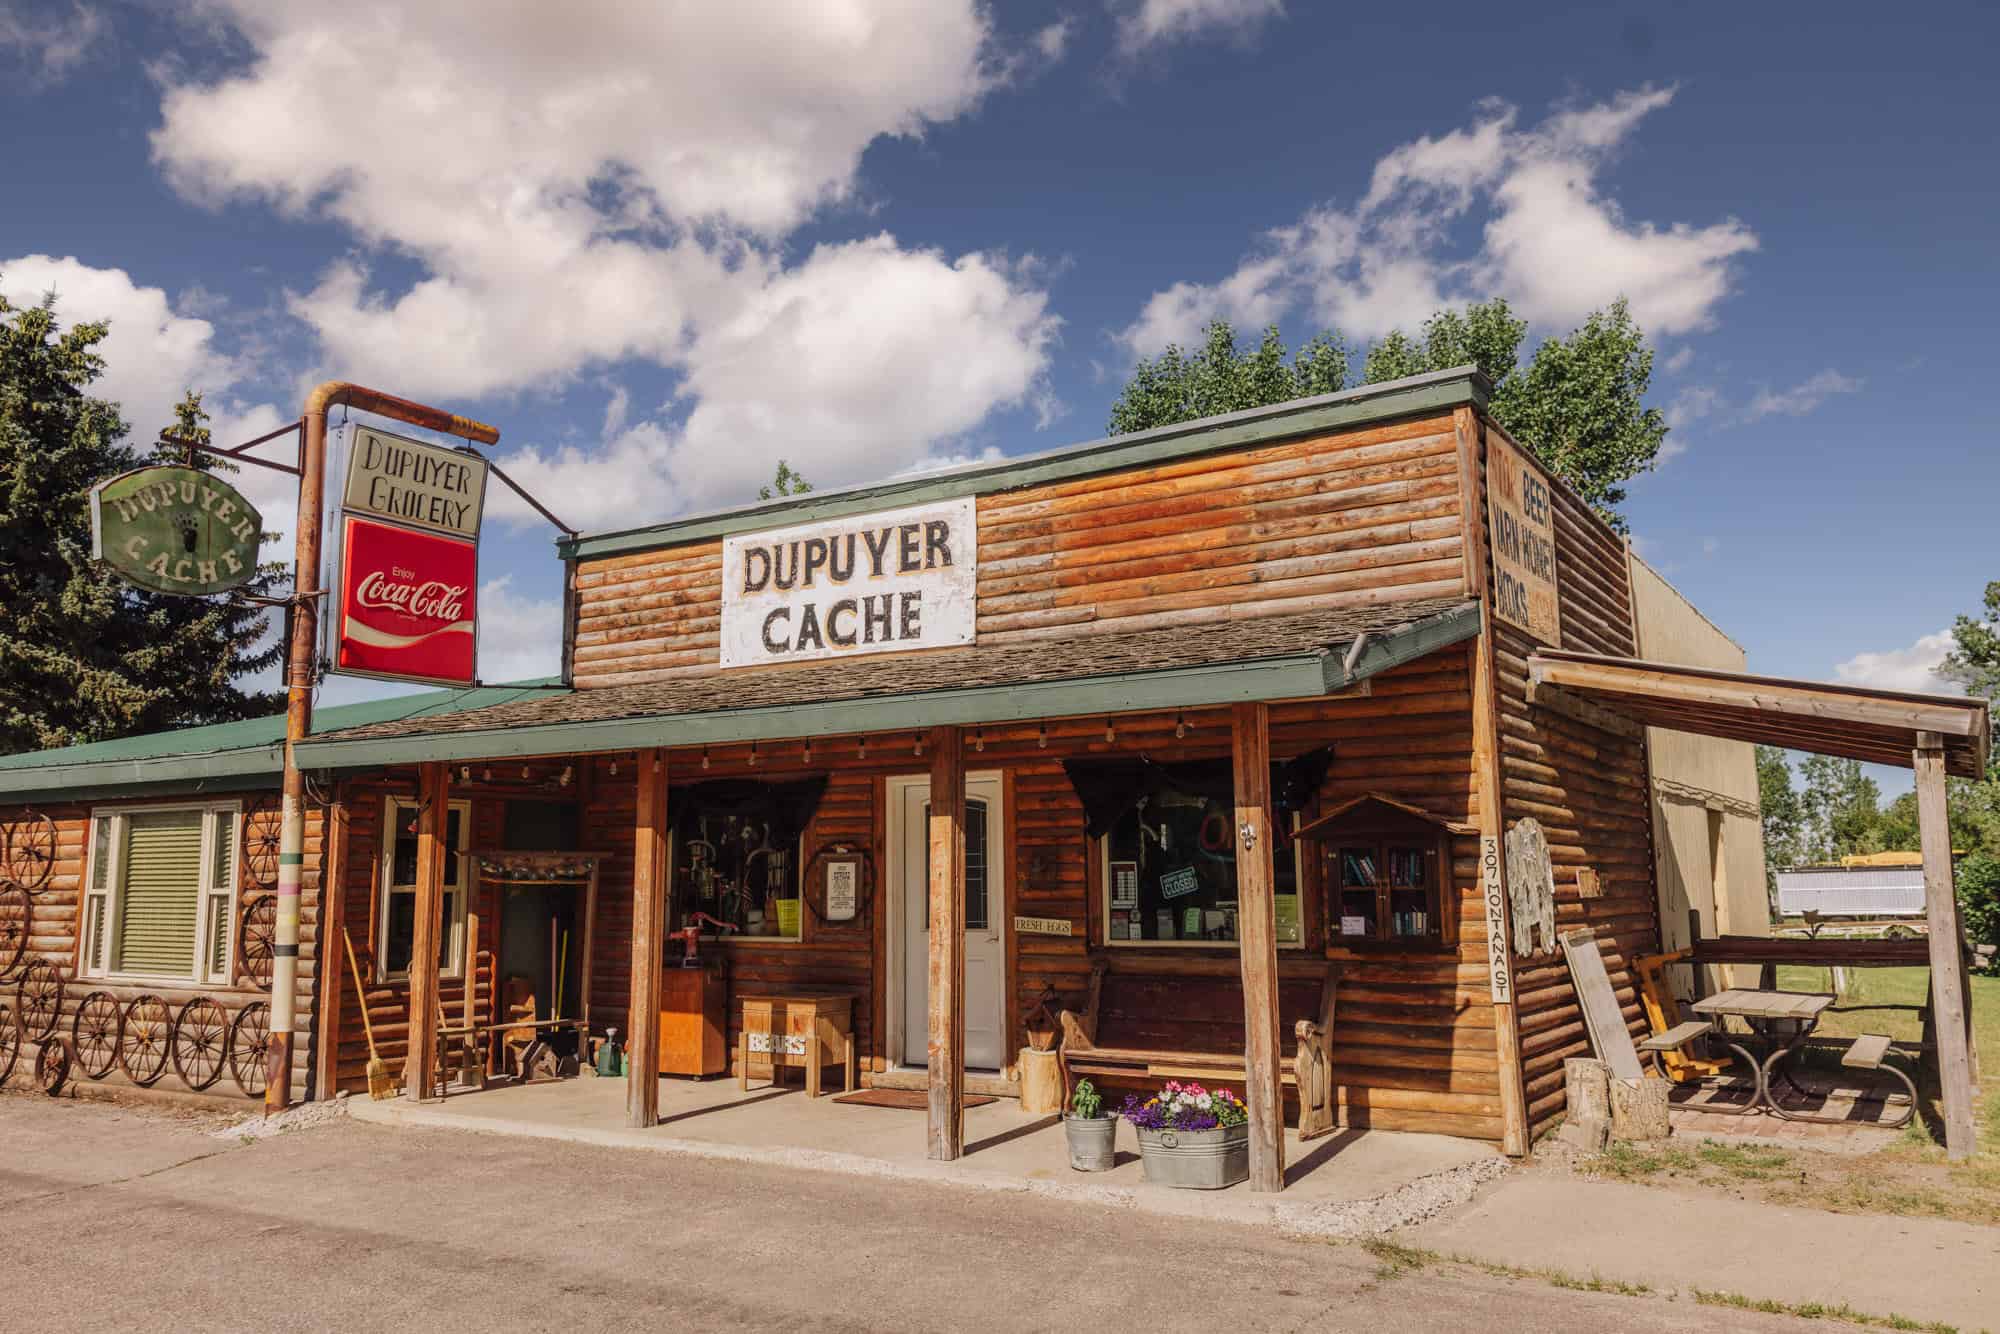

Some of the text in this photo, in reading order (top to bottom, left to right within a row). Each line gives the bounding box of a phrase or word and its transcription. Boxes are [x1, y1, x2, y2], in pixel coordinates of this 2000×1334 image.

[361, 435, 471, 495] DUPUYER
[112, 480, 255, 543] DUPUYER
[369, 476, 471, 528] GROCERY
[1523, 470, 1552, 529] BEER
[127, 535, 243, 585] CACHE
[392, 566, 416, 580] Enjoy
[743, 519, 954, 594] DUPUYER
[356, 571, 468, 621] Coca-Cola
[761, 590, 922, 655] CACHE
[1165, 877, 1195, 896] CLOSED
[1484, 839, 1508, 997] 307 MONTANA ST
